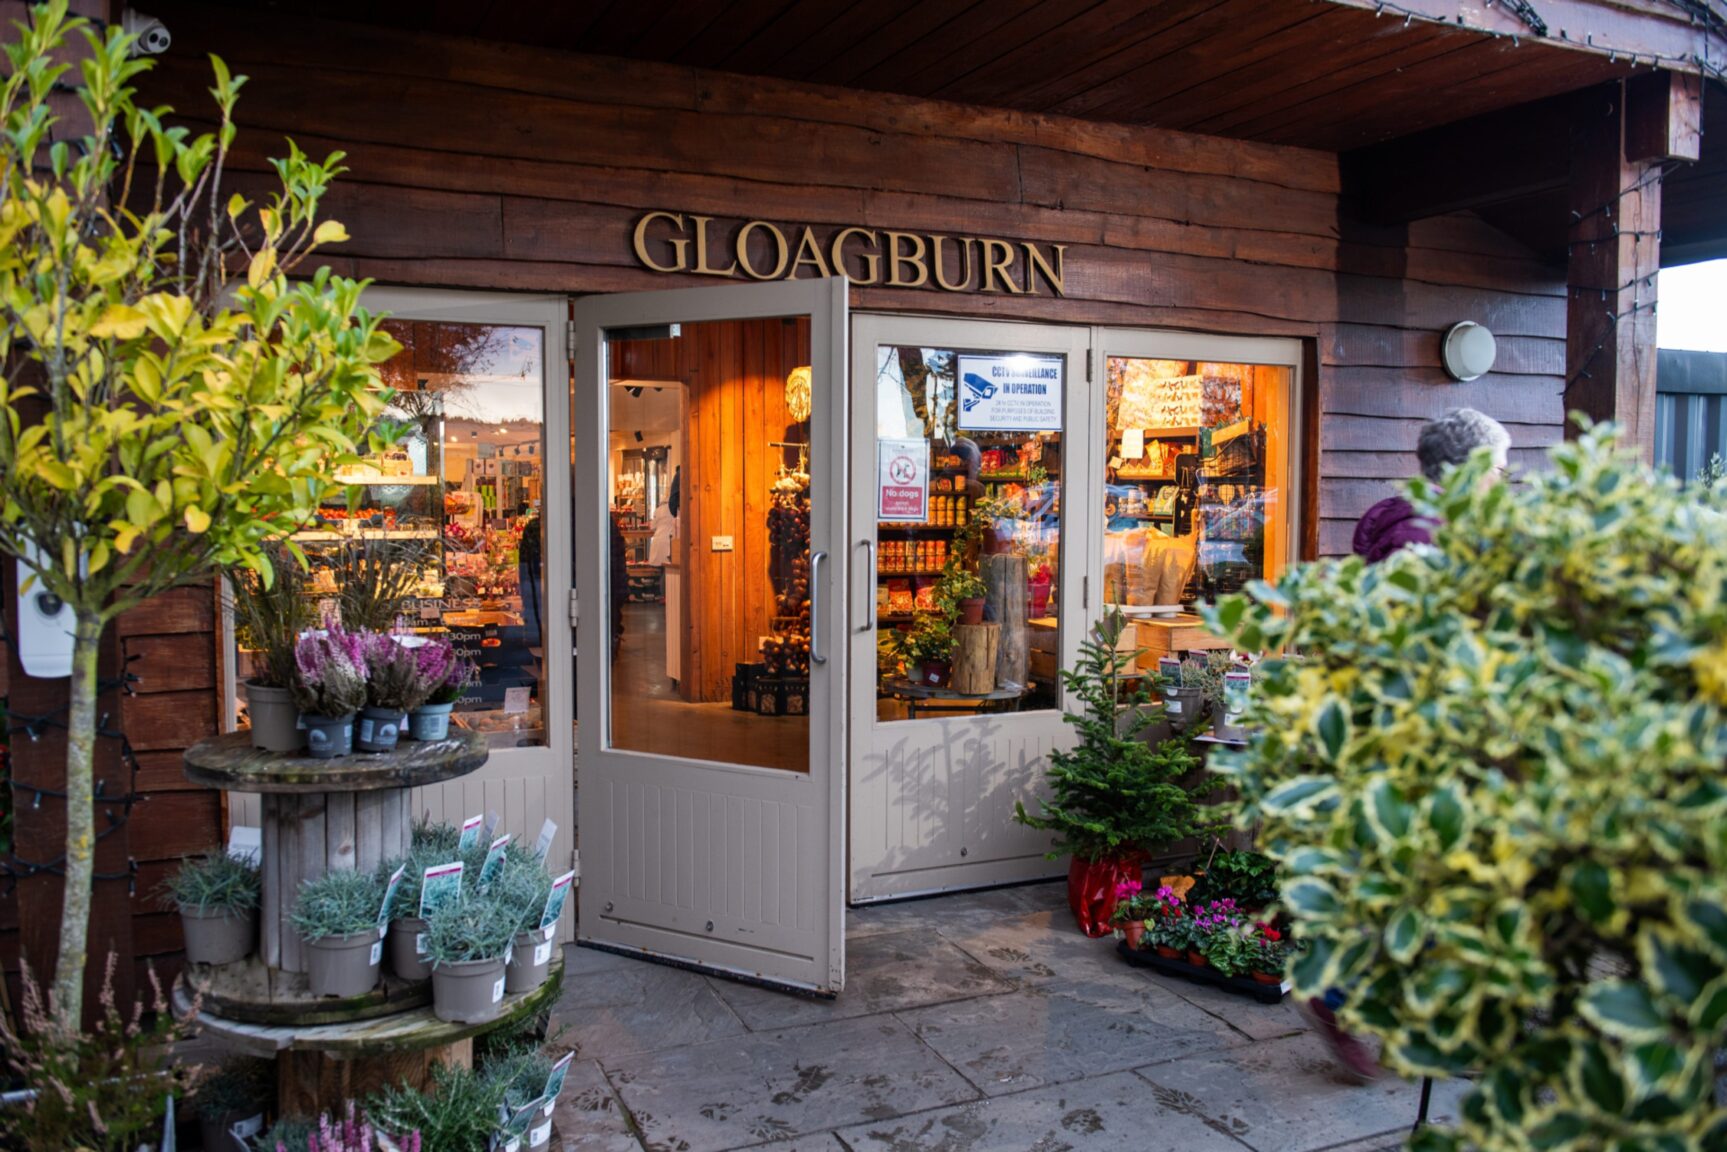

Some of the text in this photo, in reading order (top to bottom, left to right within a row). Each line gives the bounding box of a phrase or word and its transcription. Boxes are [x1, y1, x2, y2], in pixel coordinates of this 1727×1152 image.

[633, 211, 1068, 297] GLOAGBURN
[992, 366, 1057, 379] CCTV SVEILLANCE
[1003, 383, 1047, 395] IN OPERATION
[886, 489, 919, 499] No dogs
[401, 598, 482, 610] BUSINESS
